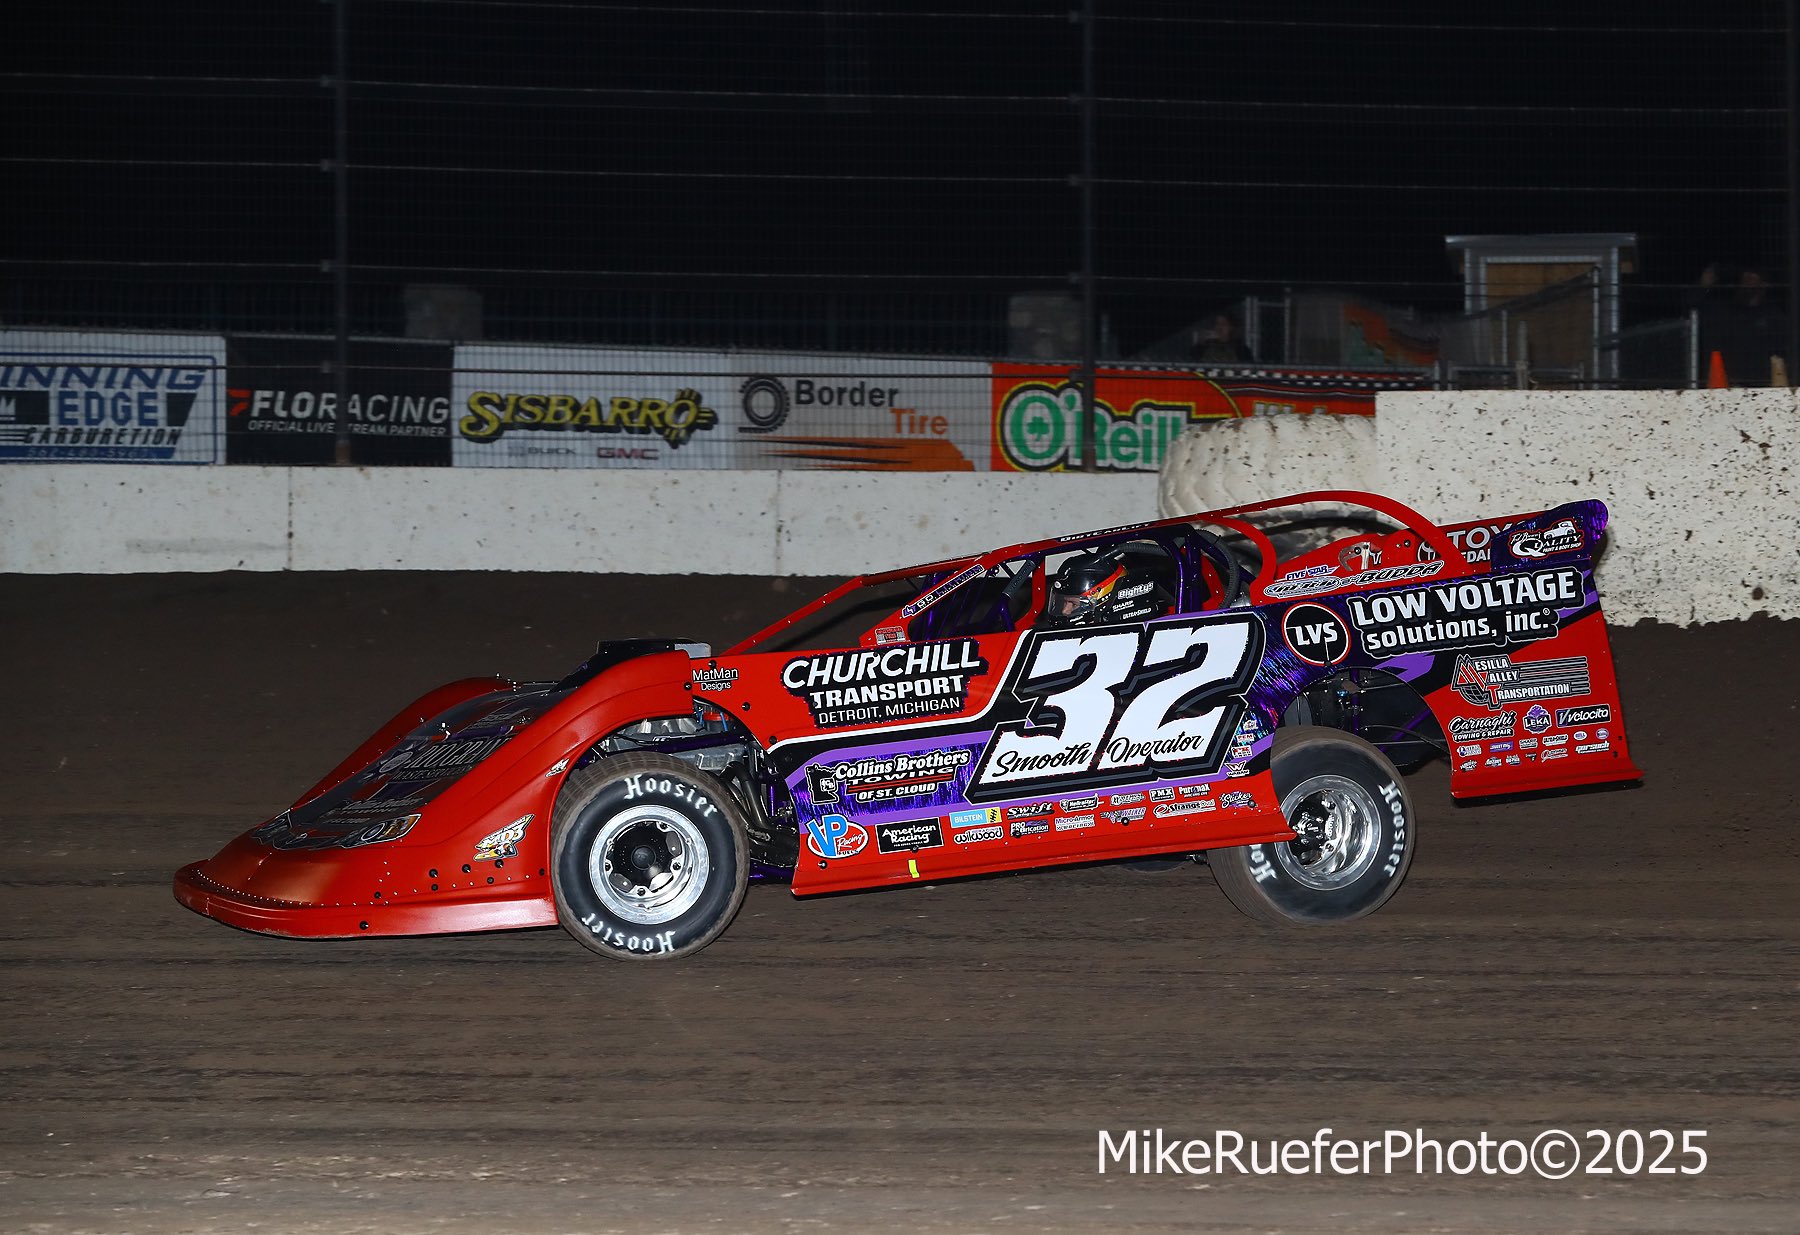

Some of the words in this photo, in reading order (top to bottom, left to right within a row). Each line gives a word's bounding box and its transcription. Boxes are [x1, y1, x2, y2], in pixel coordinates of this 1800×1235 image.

[795, 379, 898, 408] Border
[58, 391, 159, 426] EDGE
[459, 391, 700, 438] SISBARRO
[248, 420, 303, 432] OFFICIAL
[306, 421, 335, 433] LIVE
[347, 424, 387, 436] TREAM
[389, 426, 446, 437] PARTNER
[890, 407, 948, 435] Tire
[25, 427, 184, 446] CARBURETION
[528, 446, 577, 456] BUICK
[597, 447, 660, 461] GMC
[1447, 521, 1525, 550] TOY
[1286, 571, 1306, 581] FIVE
[1352, 593, 1426, 626] LOW
[1439, 572, 1577, 612] VOLTAGE
[1294, 622, 1338, 646] LVS
[1368, 617, 1498, 650] solutions,
[692, 667, 739, 681] MatMan
[783, 641, 981, 689] CHURCHILL
[701, 681, 732, 692] Designs
[809, 675, 964, 709] TRANSPORT
[1487, 683, 1570, 704] TRANSPORTATION
[886, 697, 960, 716] MICHIGAN
[980, 622, 1250, 784] 32
[1524, 716, 1550, 728] LEKA
[1453, 732, 1480, 741] TOWING
[1487, 728, 1512, 737] REPAIR
[992, 742, 1093, 778] Smooth
[1107, 731, 1204, 763] Operator
[836, 758, 893, 779] Collins
[896, 751, 969, 771] Brothers
[846, 767, 954, 786] TOWING
[624, 774, 718, 817] Hoosier
[858, 791, 874, 801] OF
[895, 783, 936, 796] CLOUD
[1150, 787, 1173, 798] PMX
[954, 813, 983, 824] BILSTEIN
[1010, 821, 1026, 830] PRO
[809, 815, 847, 856] VP
[882, 825, 936, 837] American
[891, 833, 930, 844] Racing
[955, 828, 1002, 843] wilwood
[1378, 780, 1406, 878] Hoosier
[582, 912, 676, 954] Hoosier
